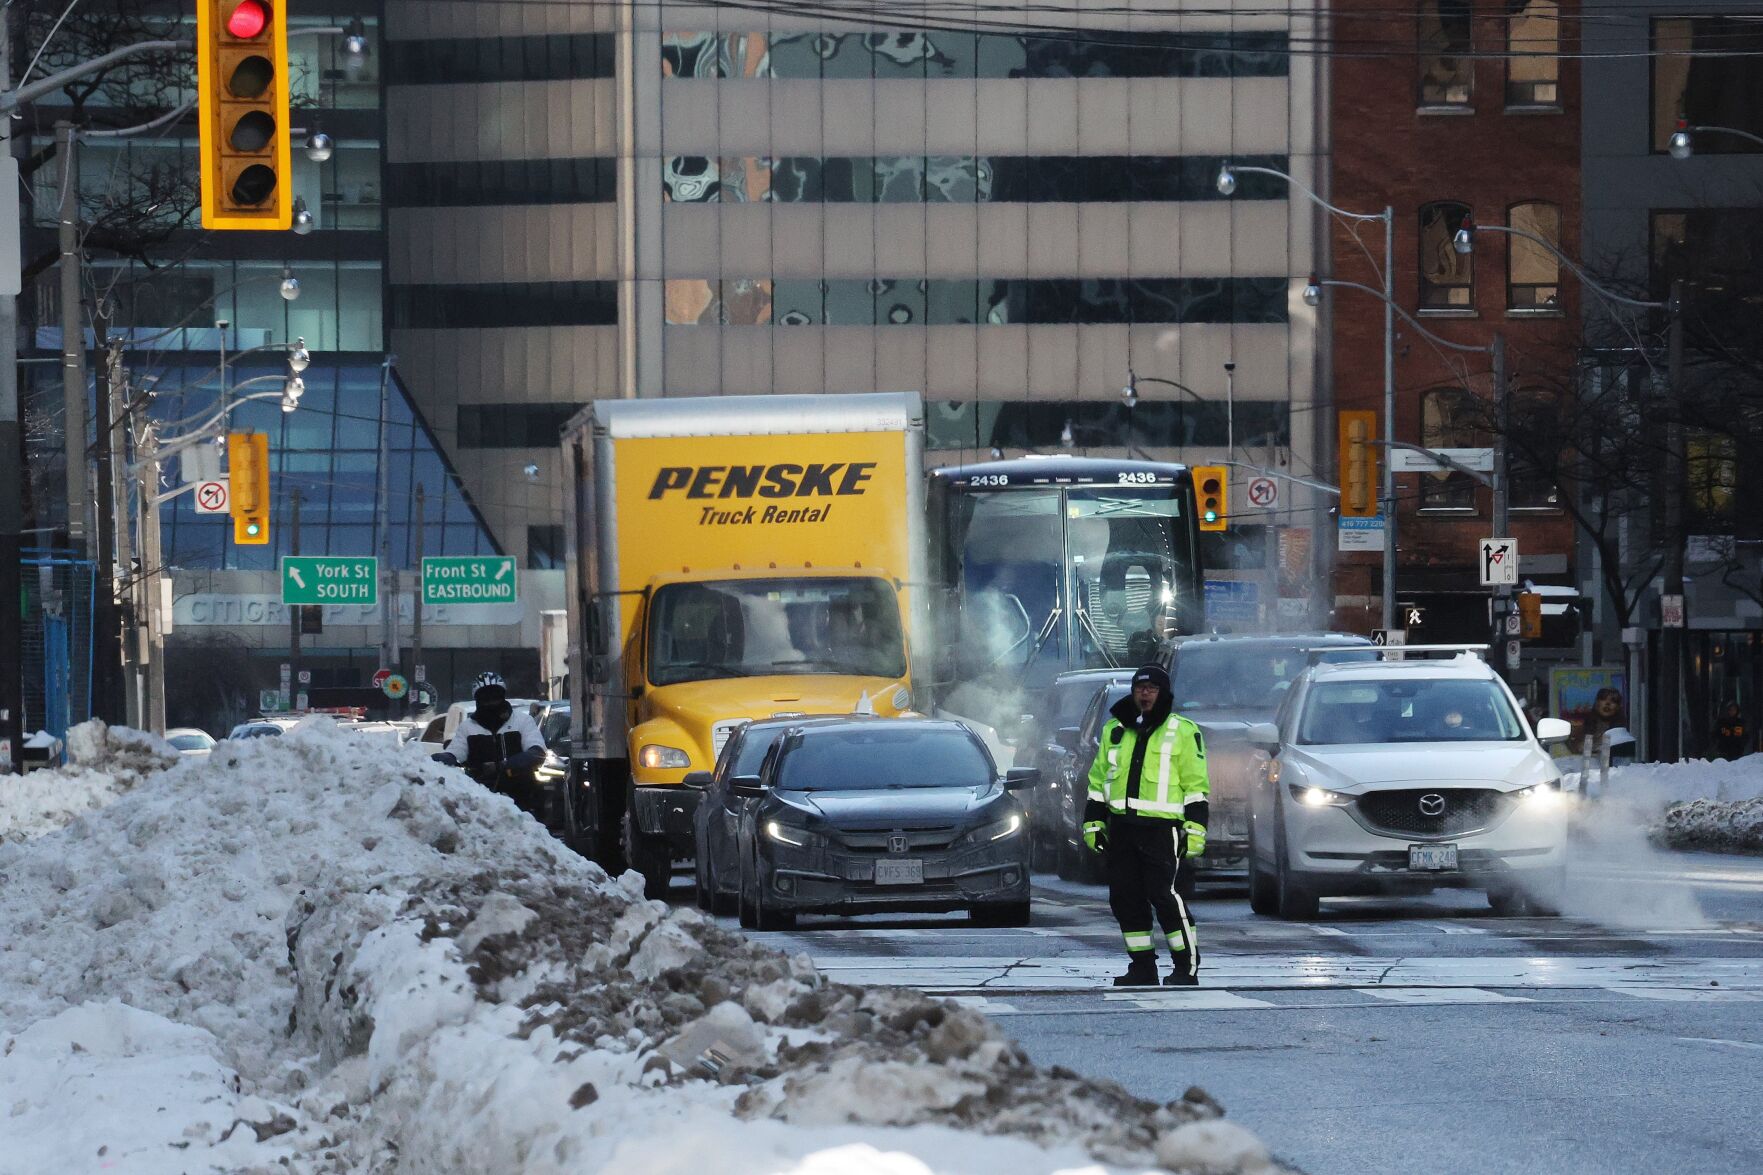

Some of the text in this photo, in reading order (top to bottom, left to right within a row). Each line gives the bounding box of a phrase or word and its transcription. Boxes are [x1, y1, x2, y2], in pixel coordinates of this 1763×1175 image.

[647, 462, 878, 500] PENSKE
[970, 474, 1009, 487] 2436
[1117, 472, 1157, 484] 2436
[699, 503, 832, 526] Truck Rental
[316, 564, 369, 578] York St
[426, 563, 486, 578] Front St
[317, 583, 369, 598] SOUTH
[428, 583, 511, 598] EASTBOUND
[191, 601, 345, 623] CITIGRP
